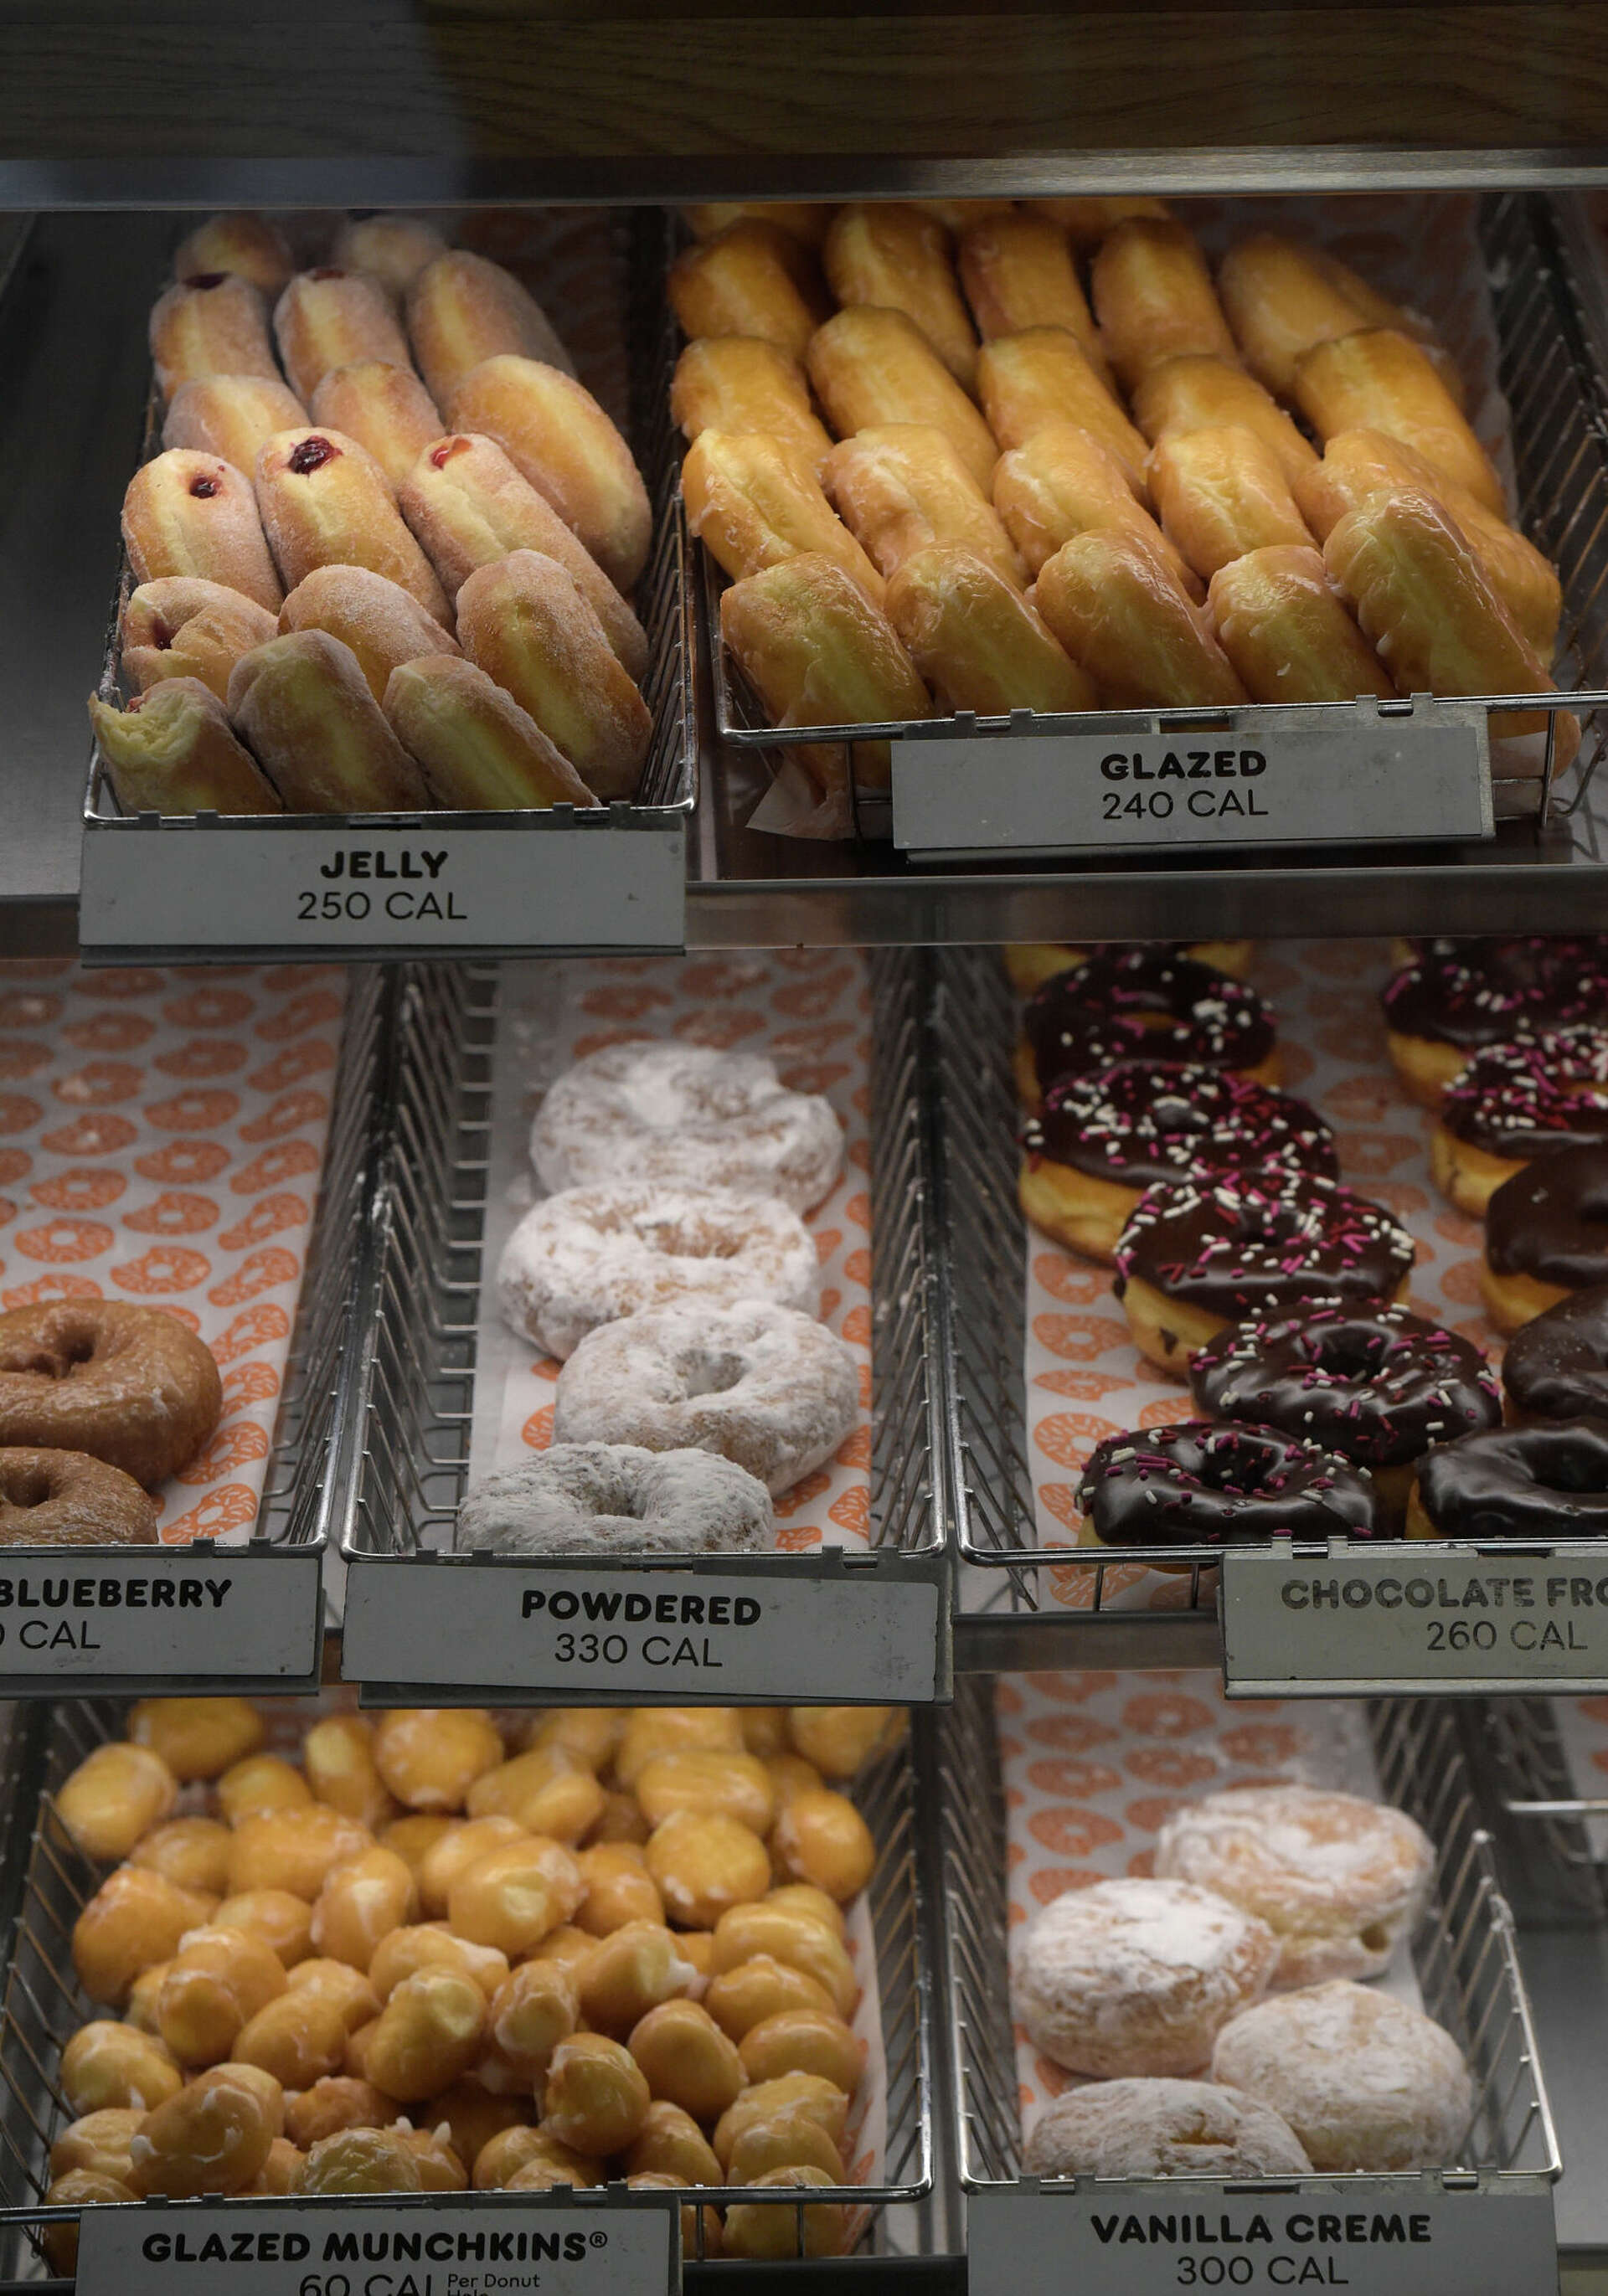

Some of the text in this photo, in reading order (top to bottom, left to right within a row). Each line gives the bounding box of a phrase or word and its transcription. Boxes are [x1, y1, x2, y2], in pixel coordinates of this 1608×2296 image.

[1100, 749, 1267, 780] GLAZED
[1102, 788, 1270, 820] 240 CAL
[320, 850, 449, 879] JELLY
[296, 891, 468, 920] 250 CAL
[0, 1578, 233, 1608] BLUEBERRY
[521, 1589, 761, 1626] POWDERED
[1281, 1578, 1535, 1609] CHOCOLATE
[19, 1619, 101, 1650] CAL
[1426, 1620, 1589, 1651] 260 CAL
[554, 1633, 723, 1668] 330 CAL
[1090, 2213, 1432, 2244] VANILLA CREME
[142, 2232, 311, 2263] GLAZED
[299, 2273, 351, 2296] 60
[447, 2273, 540, 2288] Per Donut
[1177, 2256, 1349, 2286] 300 CAL
